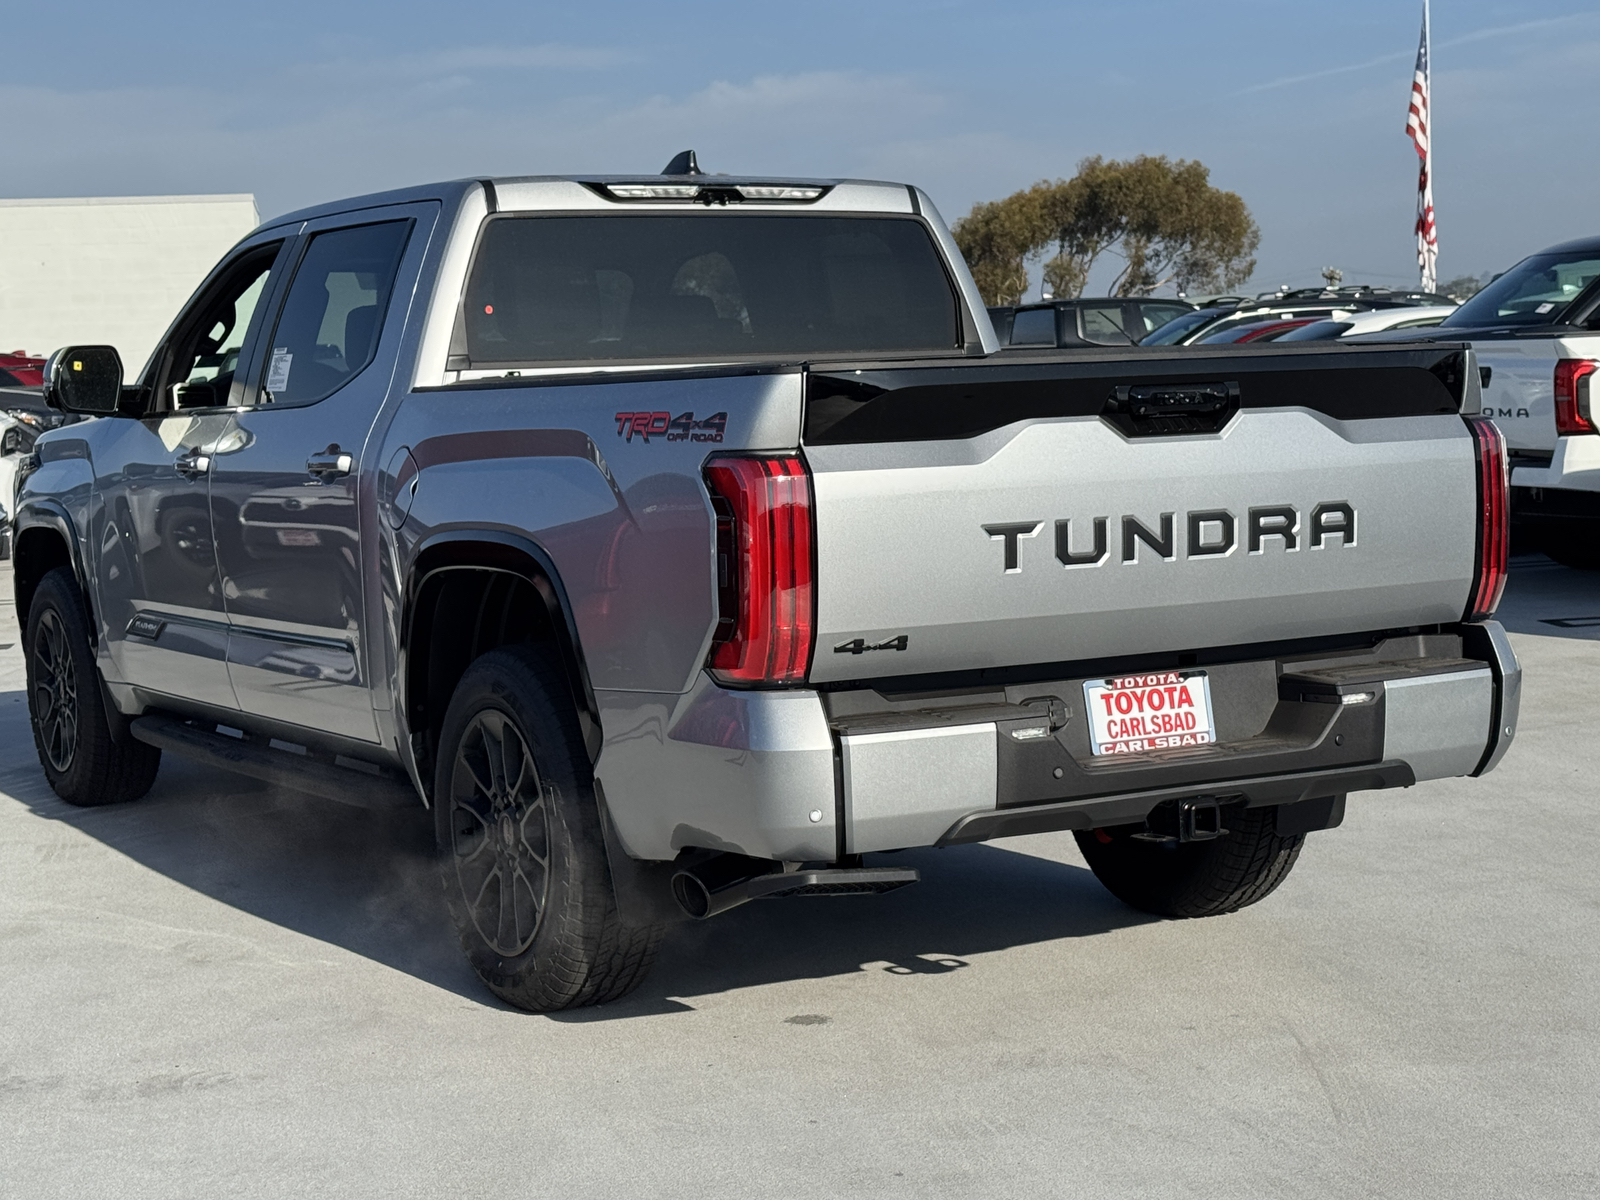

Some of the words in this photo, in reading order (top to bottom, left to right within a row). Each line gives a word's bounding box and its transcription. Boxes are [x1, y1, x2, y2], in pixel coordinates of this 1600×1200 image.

[1482, 407, 1530, 418] OMA
[615, 411, 671, 443] TRD
[667, 432, 689, 442] OFF
[690, 433, 724, 443] ROAD
[981, 500, 1358, 574] TUNDRA
[1114, 673, 1178, 689] TOYOTA
[1100, 685, 1194, 716] TOYOTA
[1106, 711, 1196, 739] CARLSBAD
[1100, 732, 1210, 755] CARLSBAD
